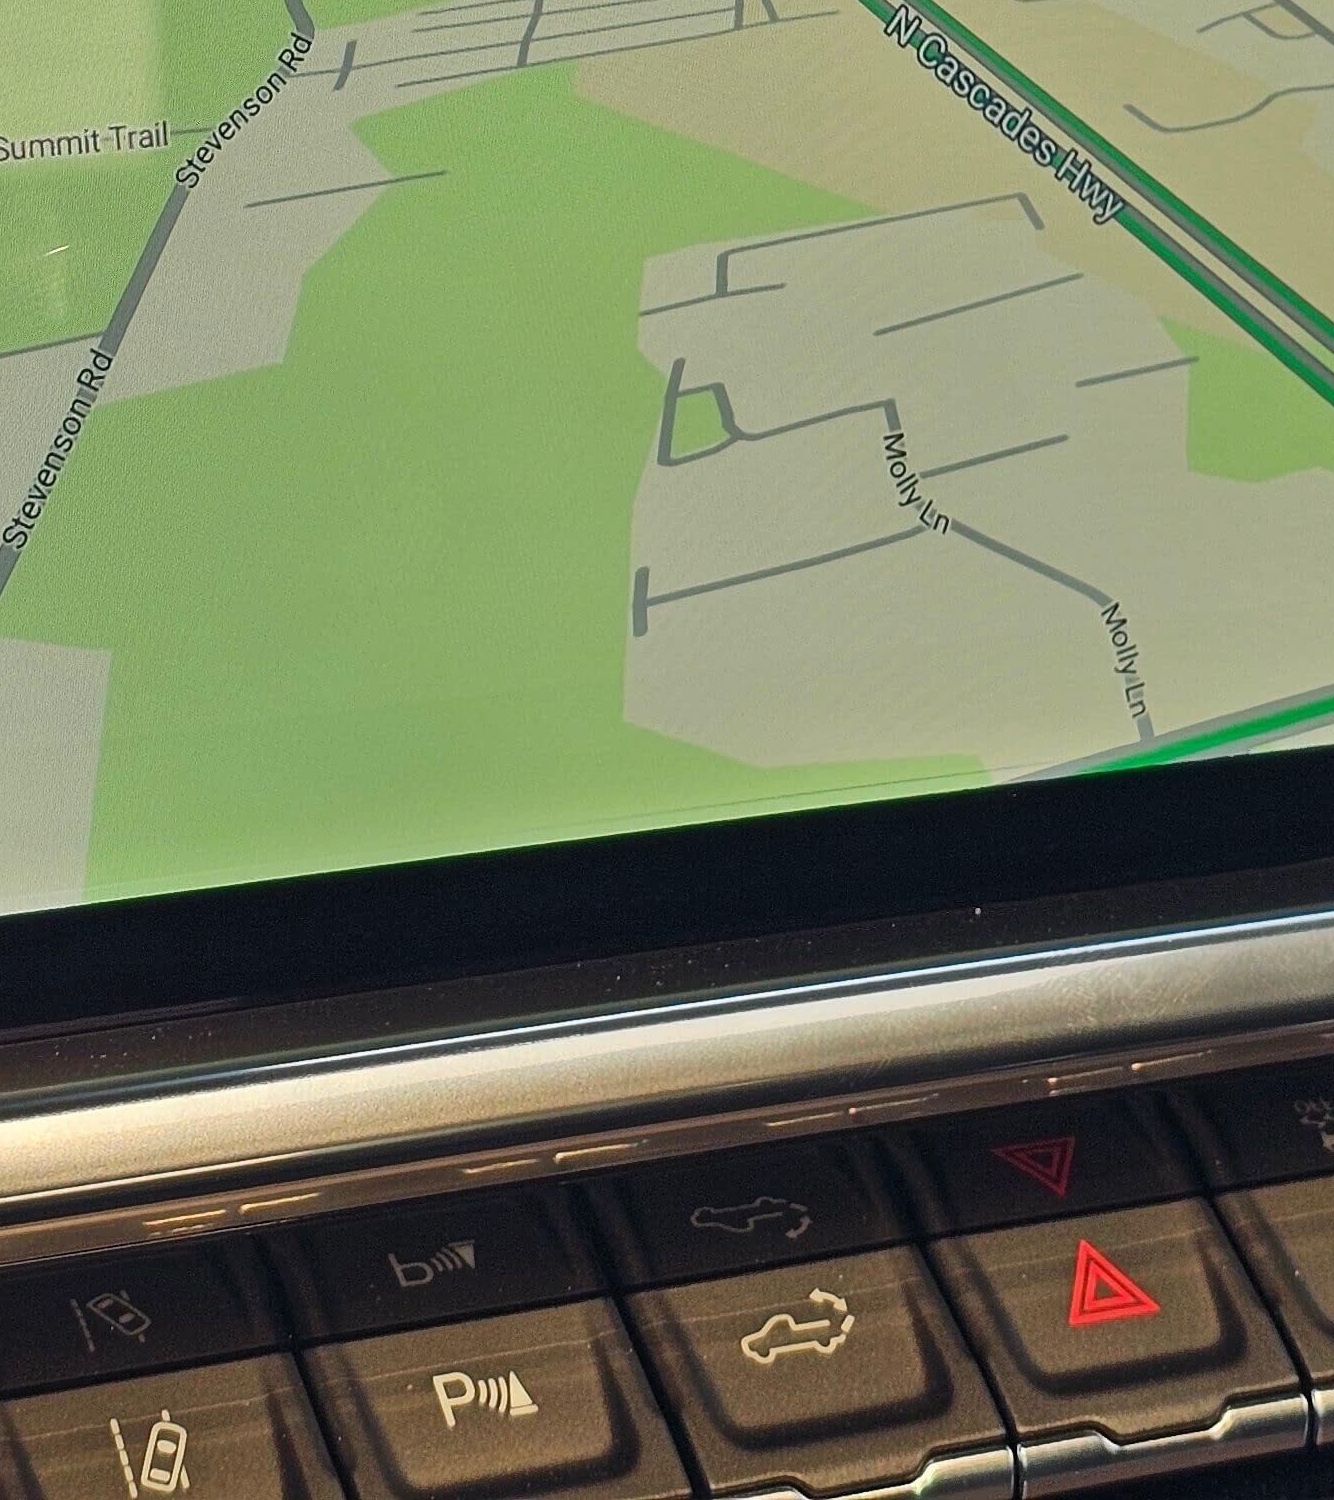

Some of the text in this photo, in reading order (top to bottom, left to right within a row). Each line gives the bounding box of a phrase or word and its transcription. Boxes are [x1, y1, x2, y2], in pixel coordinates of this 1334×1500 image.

[109, 120, 170, 152] Trail
[175, 32, 315, 191] Stevenson Rd
[885, 3, 1125, 226] N Cascades Hwy
[3, 348, 114, 550] Stevenson Rd
[883, 432, 951, 534] Molly Ln
[1101, 602, 1147, 718] Molly Ln
[433, 1371, 476, 1427] P
